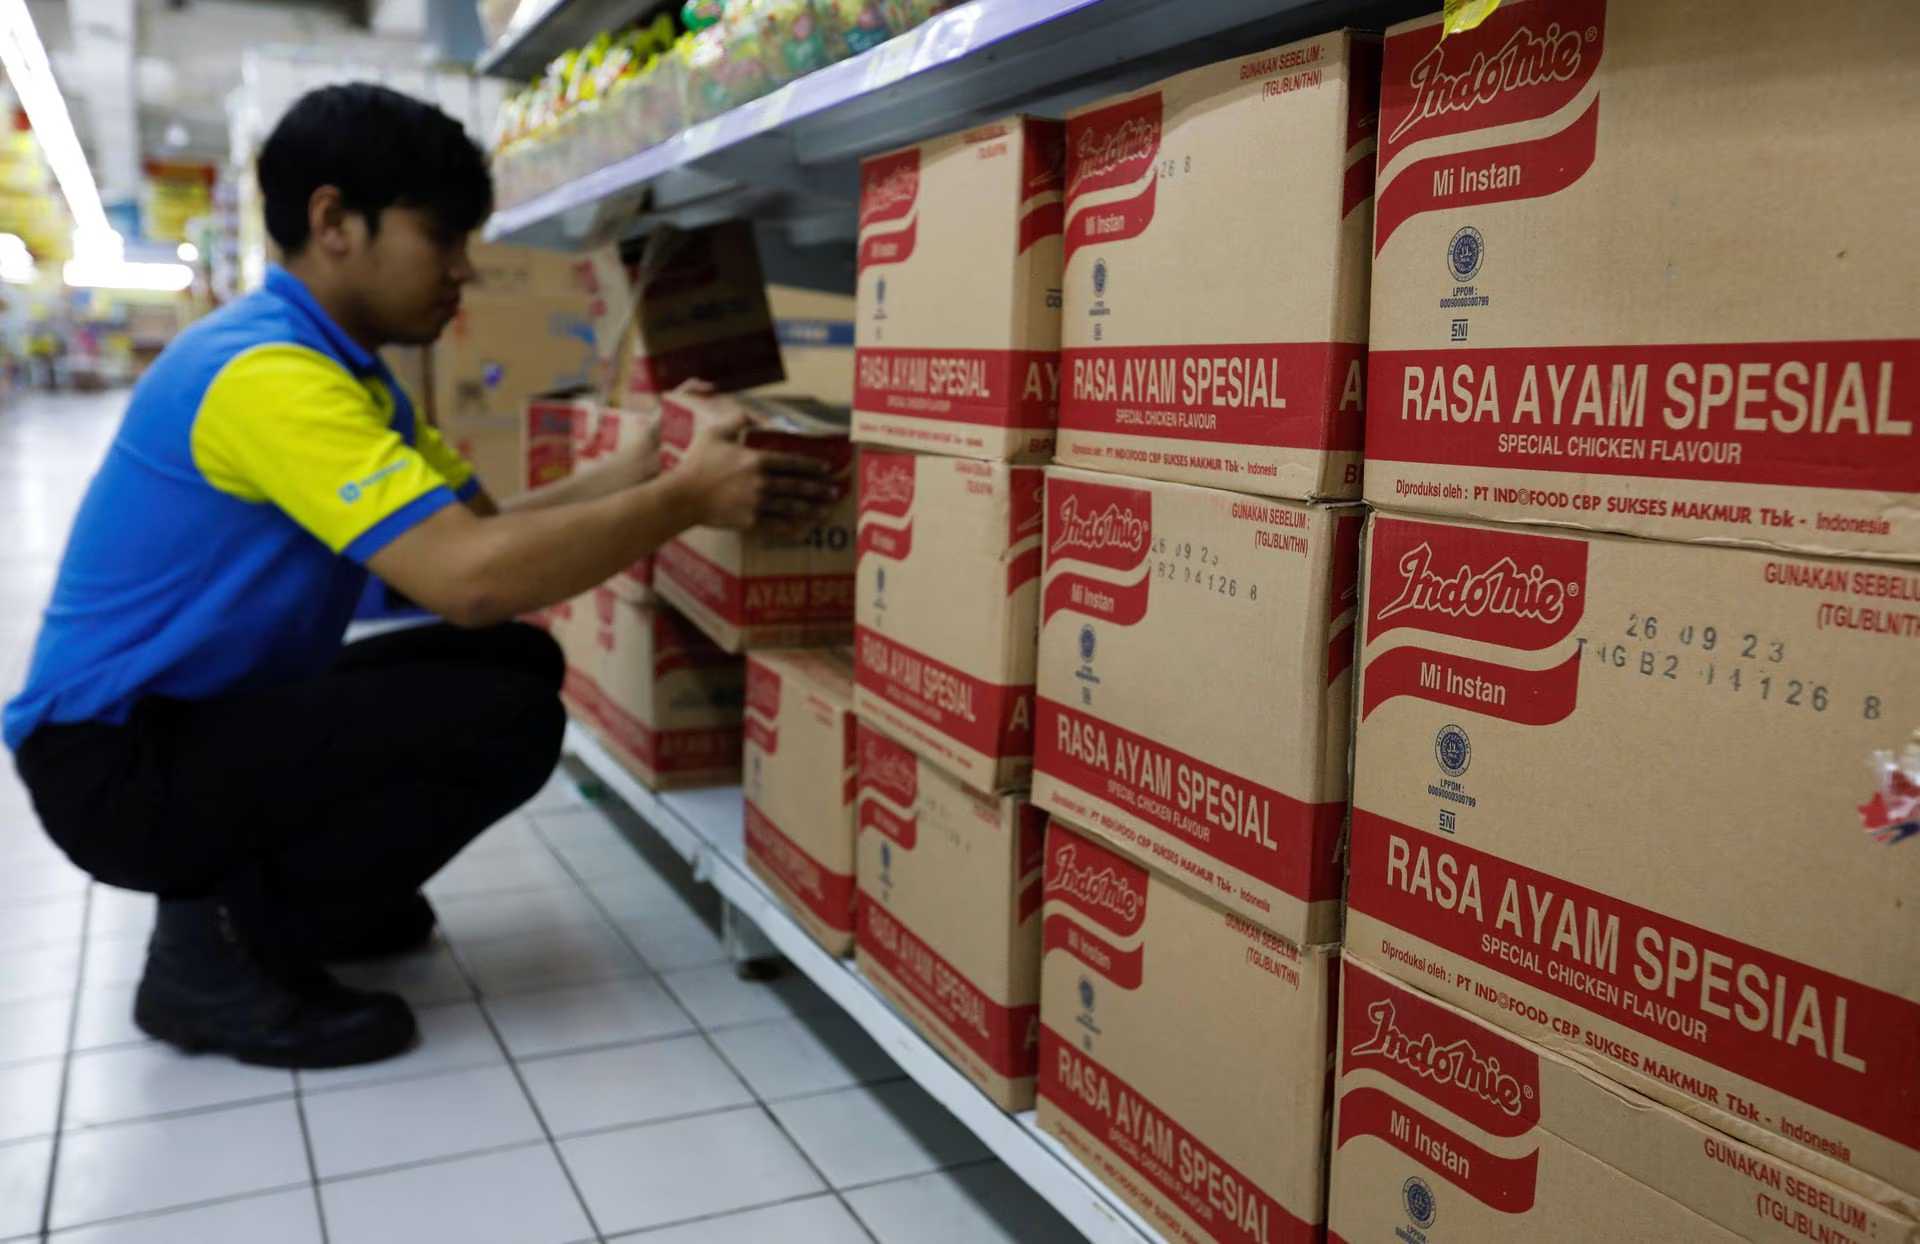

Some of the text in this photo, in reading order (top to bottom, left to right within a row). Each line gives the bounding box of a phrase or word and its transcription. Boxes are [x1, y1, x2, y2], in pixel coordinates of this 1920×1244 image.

[1239, 57, 1278, 81] GUNAKAN
[1279, 44, 1319, 71] SEBELUM
[1262, 68, 1322, 102] (TGL/BLN/THN)
[1388, 23, 1581, 144] Indomie
[1433, 162, 1521, 198] Mi Instan
[1452, 286, 1474, 297] LPPOM
[1451, 322, 1468, 337] SNI
[929, 357, 990, 398] SPESIAL
[1073, 356, 1286, 409] RASA AYAM SPESIAL
[1401, 360, 1912, 436] RASA AYAM SPESIAL
[1498, 433, 1742, 465] SPECIAL CHICKEN FLAVOUR
[1232, 502, 1267, 524] GUNAKAN
[1269, 506, 1306, 529] SEBELUM
[1396, 479, 1441, 499] Diproduksi
[1443, 483, 1463, 499] oleh
[1473, 486, 1489, 502] PT
[1572, 492, 1602, 511] CBP
[1607, 495, 1668, 517] SUKSES
[1671, 500, 1752, 525] MAKMUR
[1759, 507, 1793, 527] Tbk
[1816, 513, 1890, 536] Indonesia
[1254, 530, 1309, 558] (TGL/BLN/THN)
[1377, 542, 1565, 624] Indomie
[1765, 562, 1848, 591] GUNAKAN
[1626, 613, 1657, 640] 26
[1741, 634, 1785, 664] 23
[1420, 662, 1506, 706] Mi Instan
[1863, 696, 1881, 720] 8
[1057, 713, 1278, 850] RASA AYAM SPESIAL
[1440, 813, 1455, 830] SNI
[1387, 834, 1868, 1073] RASA AYAM SPESIAL
[1481, 933, 1708, 1044] SPECIAL CHICKEN FLAVOUR
[1351, 999, 1523, 1116] Indomie
[1381, 939, 1426, 969] Diproduksi
[1427, 960, 1446, 981] oleh
[1456, 974, 1471, 993] PT
[1552, 1016, 1580, 1039] CBP
[1586, 1030, 1640, 1068] SUKSES
[1643, 1056, 1718, 1104] MAKMUR
[1726, 1092, 1760, 1123] Tbk
[1780, 1116, 1851, 1162] Indonesia
[1058, 1047, 1112, 1118] RASA
[1116, 1091, 1174, 1169] AYAM
[1390, 1109, 1470, 1180] Mi Instan
[1704, 1138, 1781, 1190] GUNAKAN
[1786, 1175, 1867, 1232] SEBELUM
